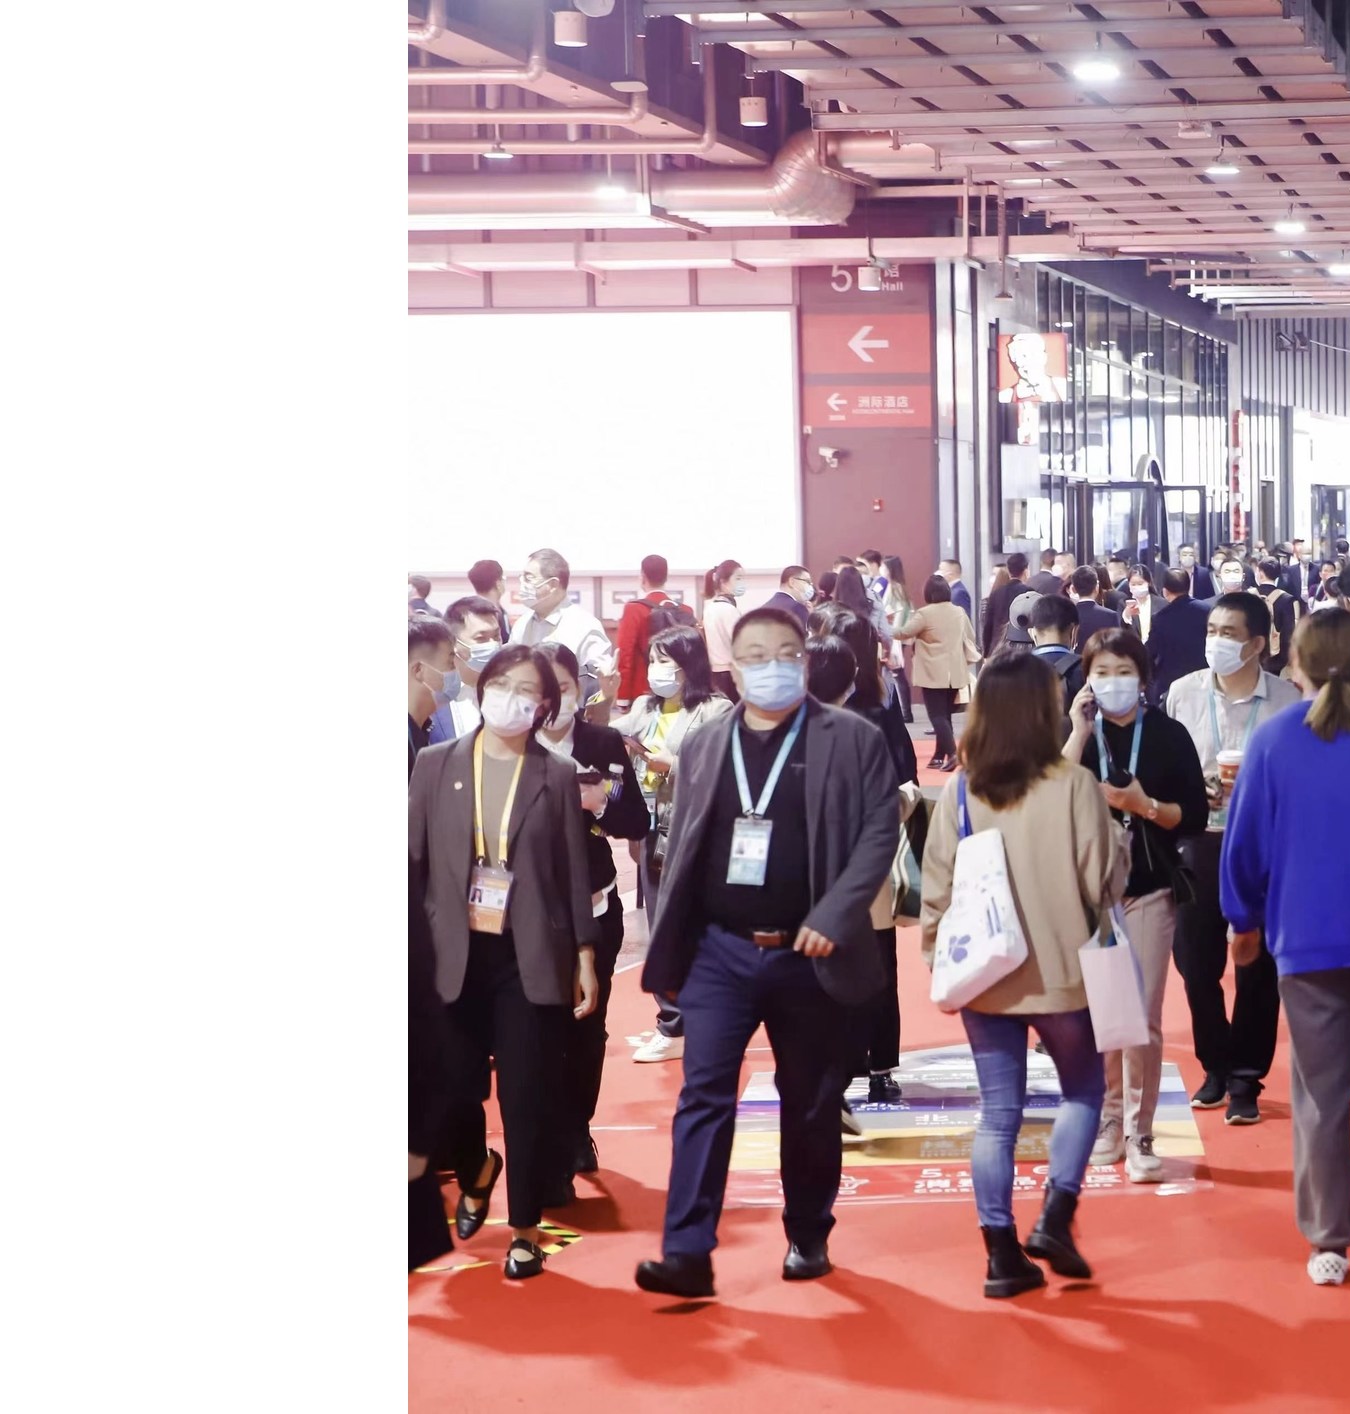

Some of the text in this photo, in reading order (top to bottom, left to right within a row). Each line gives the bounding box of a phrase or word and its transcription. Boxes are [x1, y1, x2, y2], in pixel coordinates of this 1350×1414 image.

[881, 281, 904, 292] Hall
[858, 395, 909, 408] 洲际酒店
